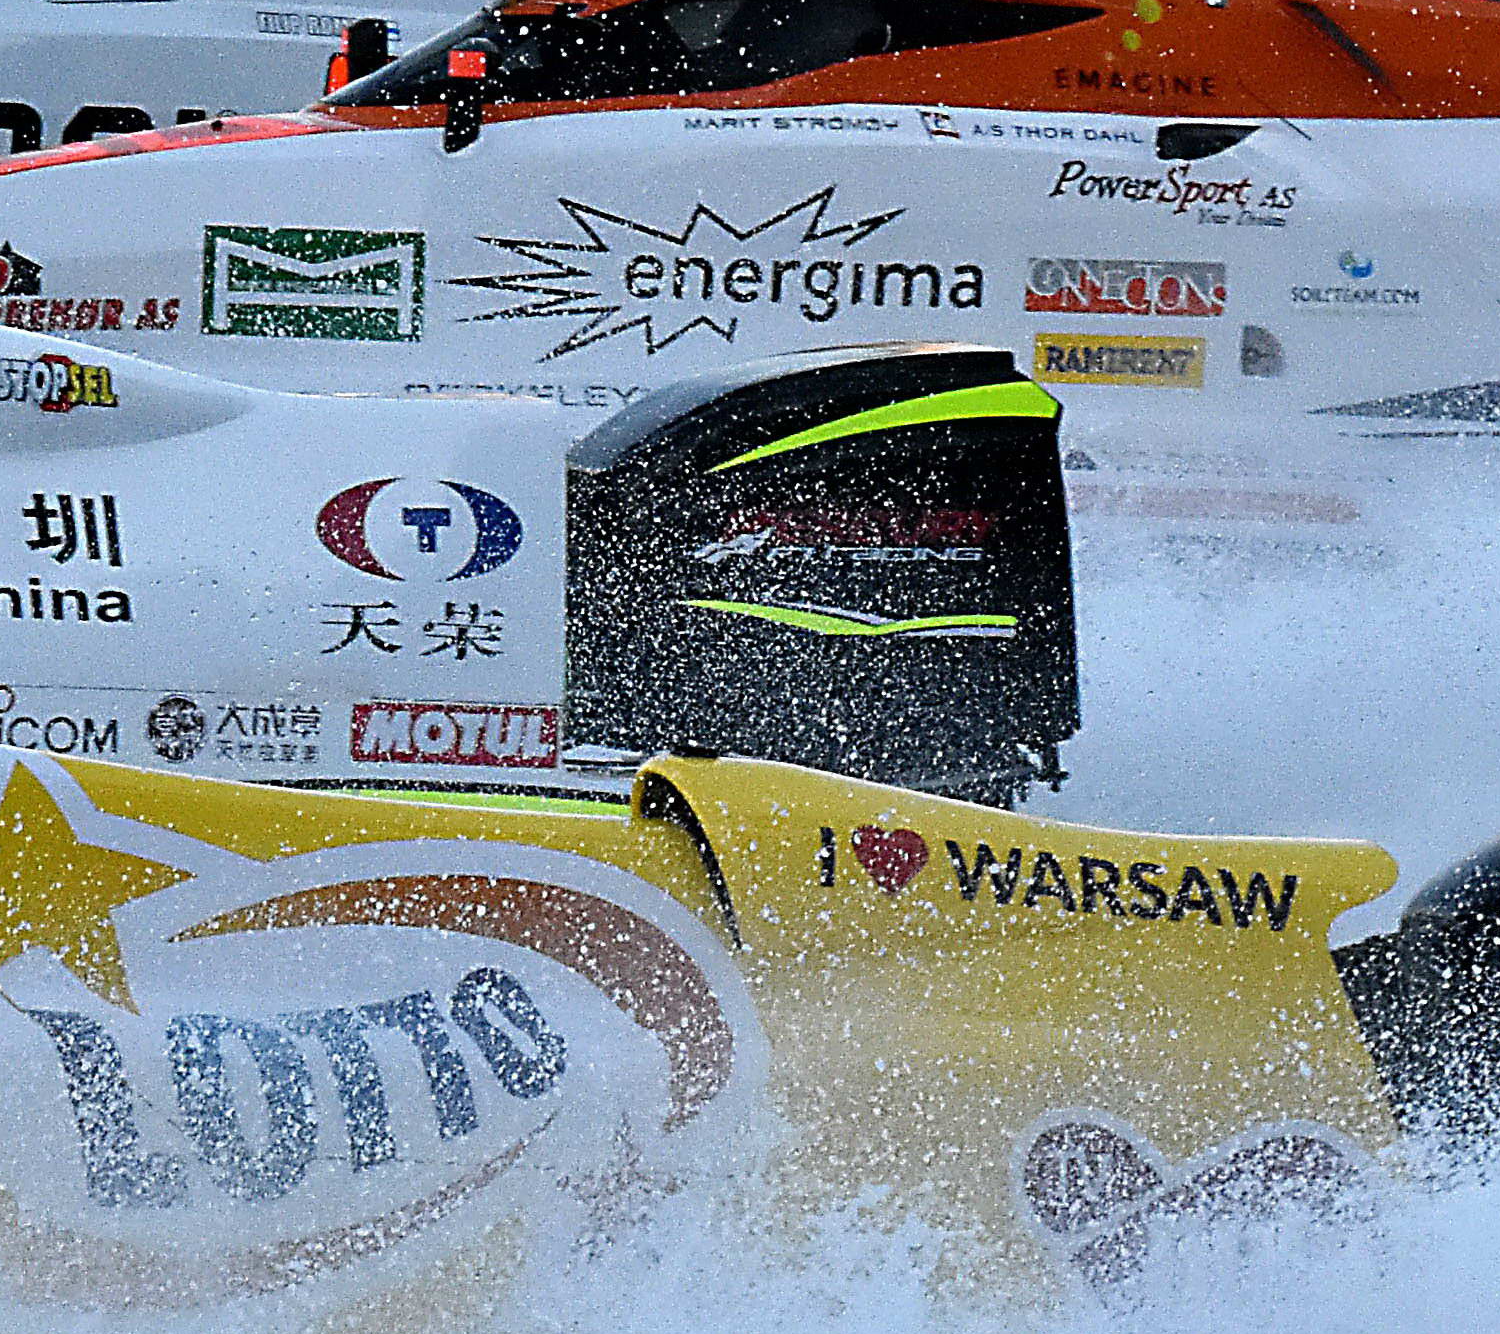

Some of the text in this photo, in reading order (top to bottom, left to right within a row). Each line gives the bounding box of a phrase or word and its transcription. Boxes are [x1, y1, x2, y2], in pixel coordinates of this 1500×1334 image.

[1014, 125, 1075, 140] THOR
[1084, 128, 1146, 144] DAHL
[1257, 186, 1297, 209] AS
[136, 297, 181, 330] AS
[624, 250, 985, 323] energima
[358, 705, 556, 765] MOTUL
[818, 825, 1299, 932] I WARSAW
[24, 964, 567, 1210] LOTTO
